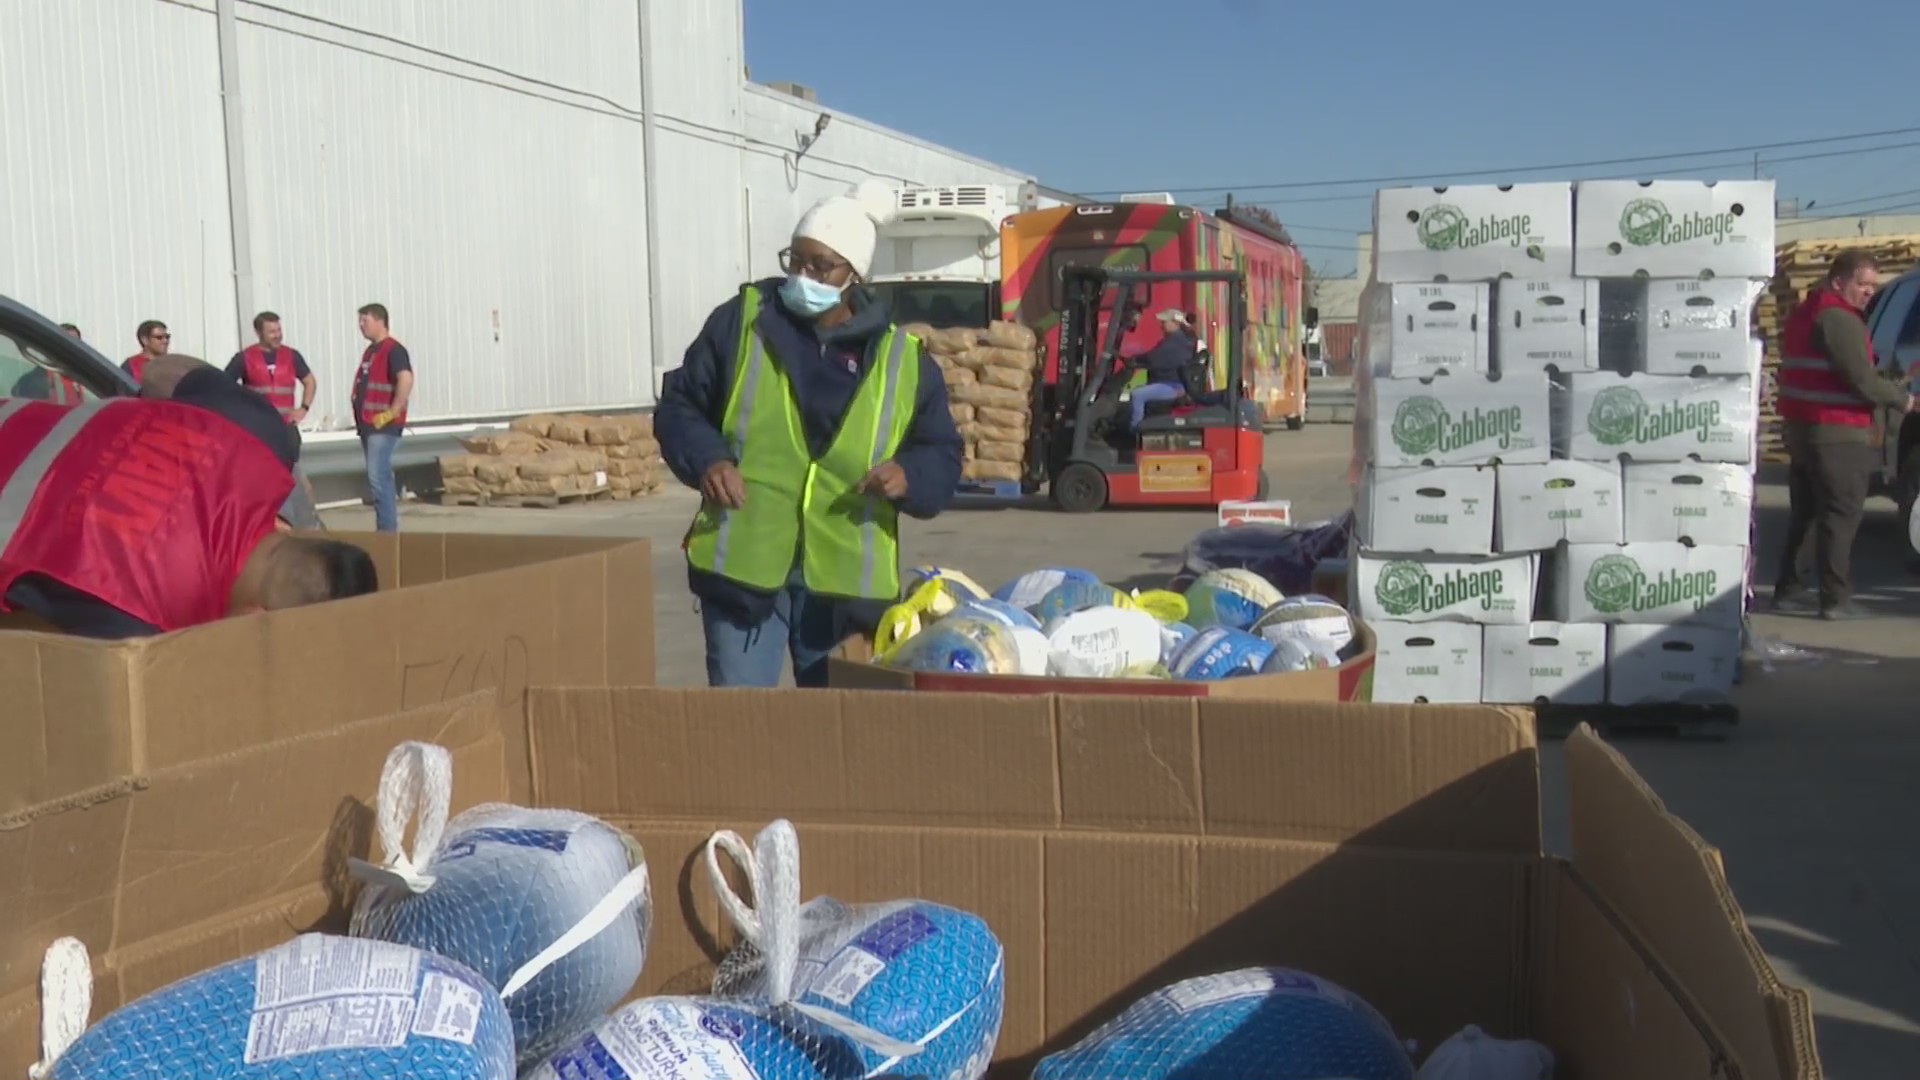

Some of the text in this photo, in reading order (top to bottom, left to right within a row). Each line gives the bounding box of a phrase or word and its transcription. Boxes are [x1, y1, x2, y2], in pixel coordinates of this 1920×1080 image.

[1458, 214, 1531, 249] Cabbage
[1660, 211, 1734, 245] Cabbage
[1060, 309, 1070, 351] TOYOTA
[1437, 405, 1521, 452] Cabbage
[1635, 399, 1720, 444] Cabbage
[1414, 514, 1448, 524] CABBAGE
[1547, 508, 1583, 520] CABBAGE
[1672, 507, 1707, 517] CABBAGE
[1420, 568, 1503, 613] Cabbage
[1632, 568, 1716, 612] Cabbage
[1406, 666, 1439, 676] CABBAGE
[1529, 667, 1563, 677] CABBAGE
[647, 1018, 688, 1065] PREMIUM
